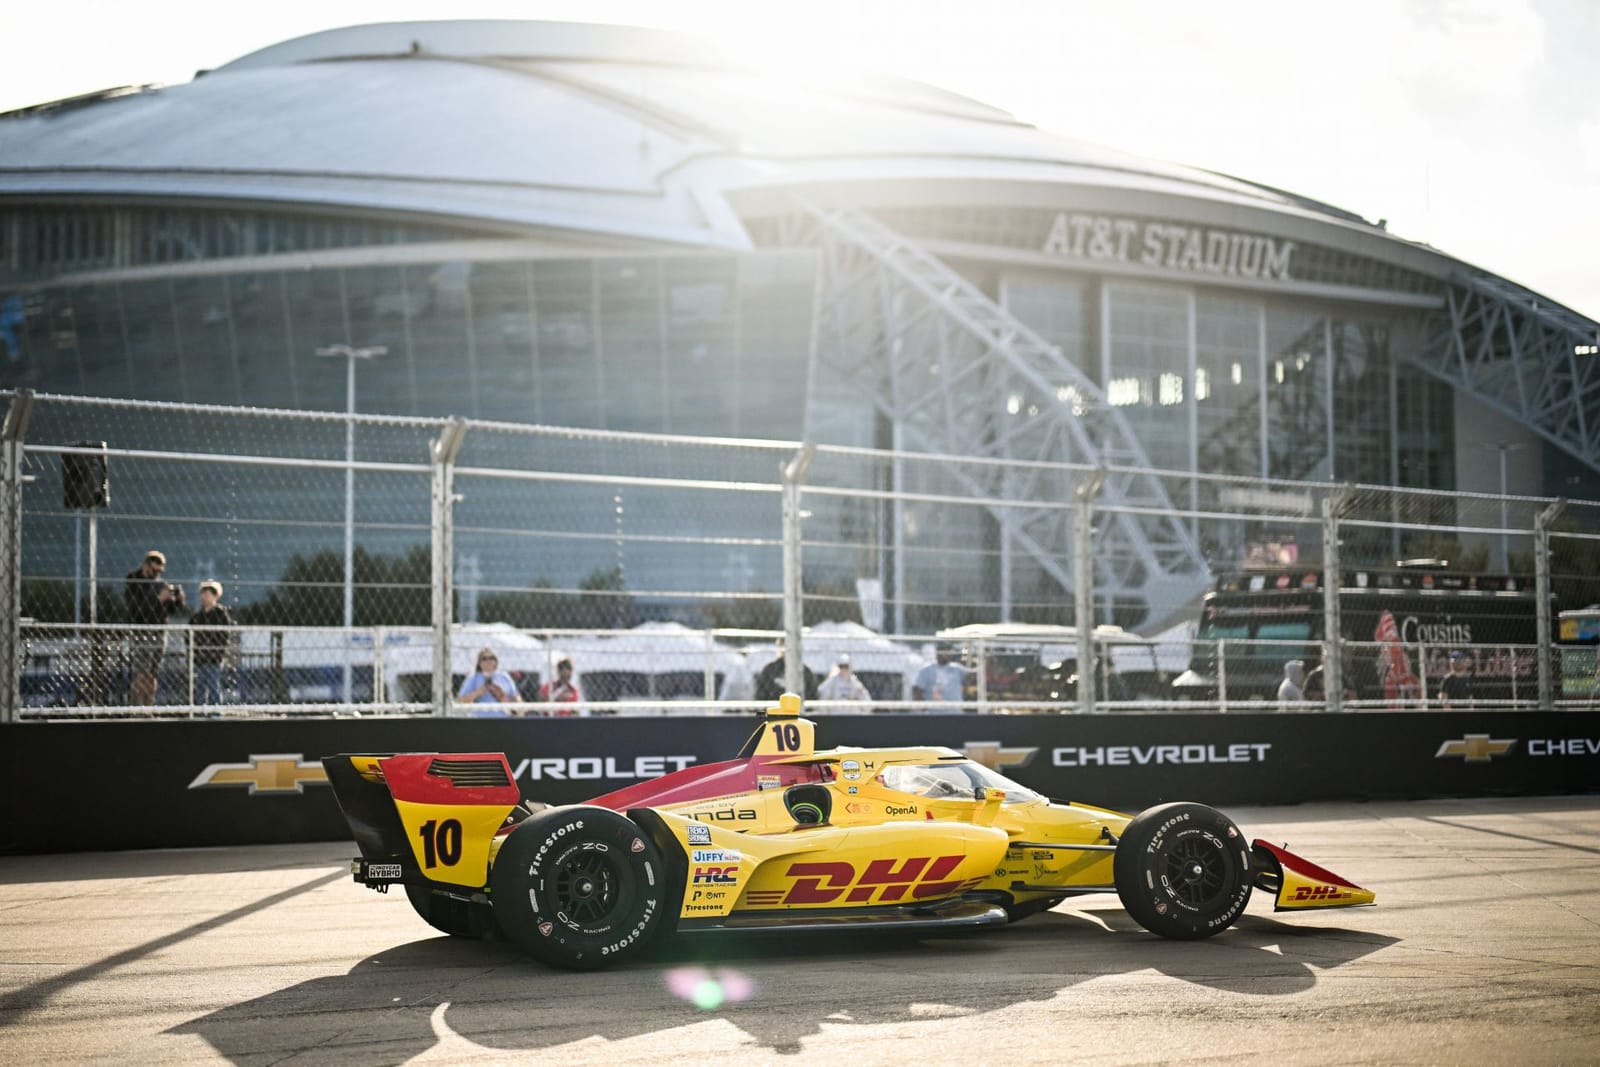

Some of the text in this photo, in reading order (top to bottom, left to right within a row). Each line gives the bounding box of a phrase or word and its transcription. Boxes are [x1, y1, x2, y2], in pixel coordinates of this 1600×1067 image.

[1044, 212, 1294, 279] AT&T STADIUM
[1402, 615, 1472, 650] Cousins
[772, 724, 801, 751] 10
[1053, 744, 1272, 766] CHEVROLET
[885, 806, 917, 816] OpenAI
[419, 818, 463, 870] 10
[1147, 813, 1190, 853] Firestone
[1202, 831, 1223, 849] OZ
[529, 820, 584, 877] Firestone
[582, 842, 609, 852] OZ
[694, 850, 724, 862] JIFFY
[693, 866, 738, 883] HRC
[782, 855, 967, 904] DHL
[1161, 874, 1176, 898] OZ
[1295, 886, 1342, 900] DHL
[685, 904, 723, 912] Firestone
[1208, 884, 1249, 928] Firestone
[557, 911, 580, 931] OZ
[601, 899, 657, 956] Firestone
